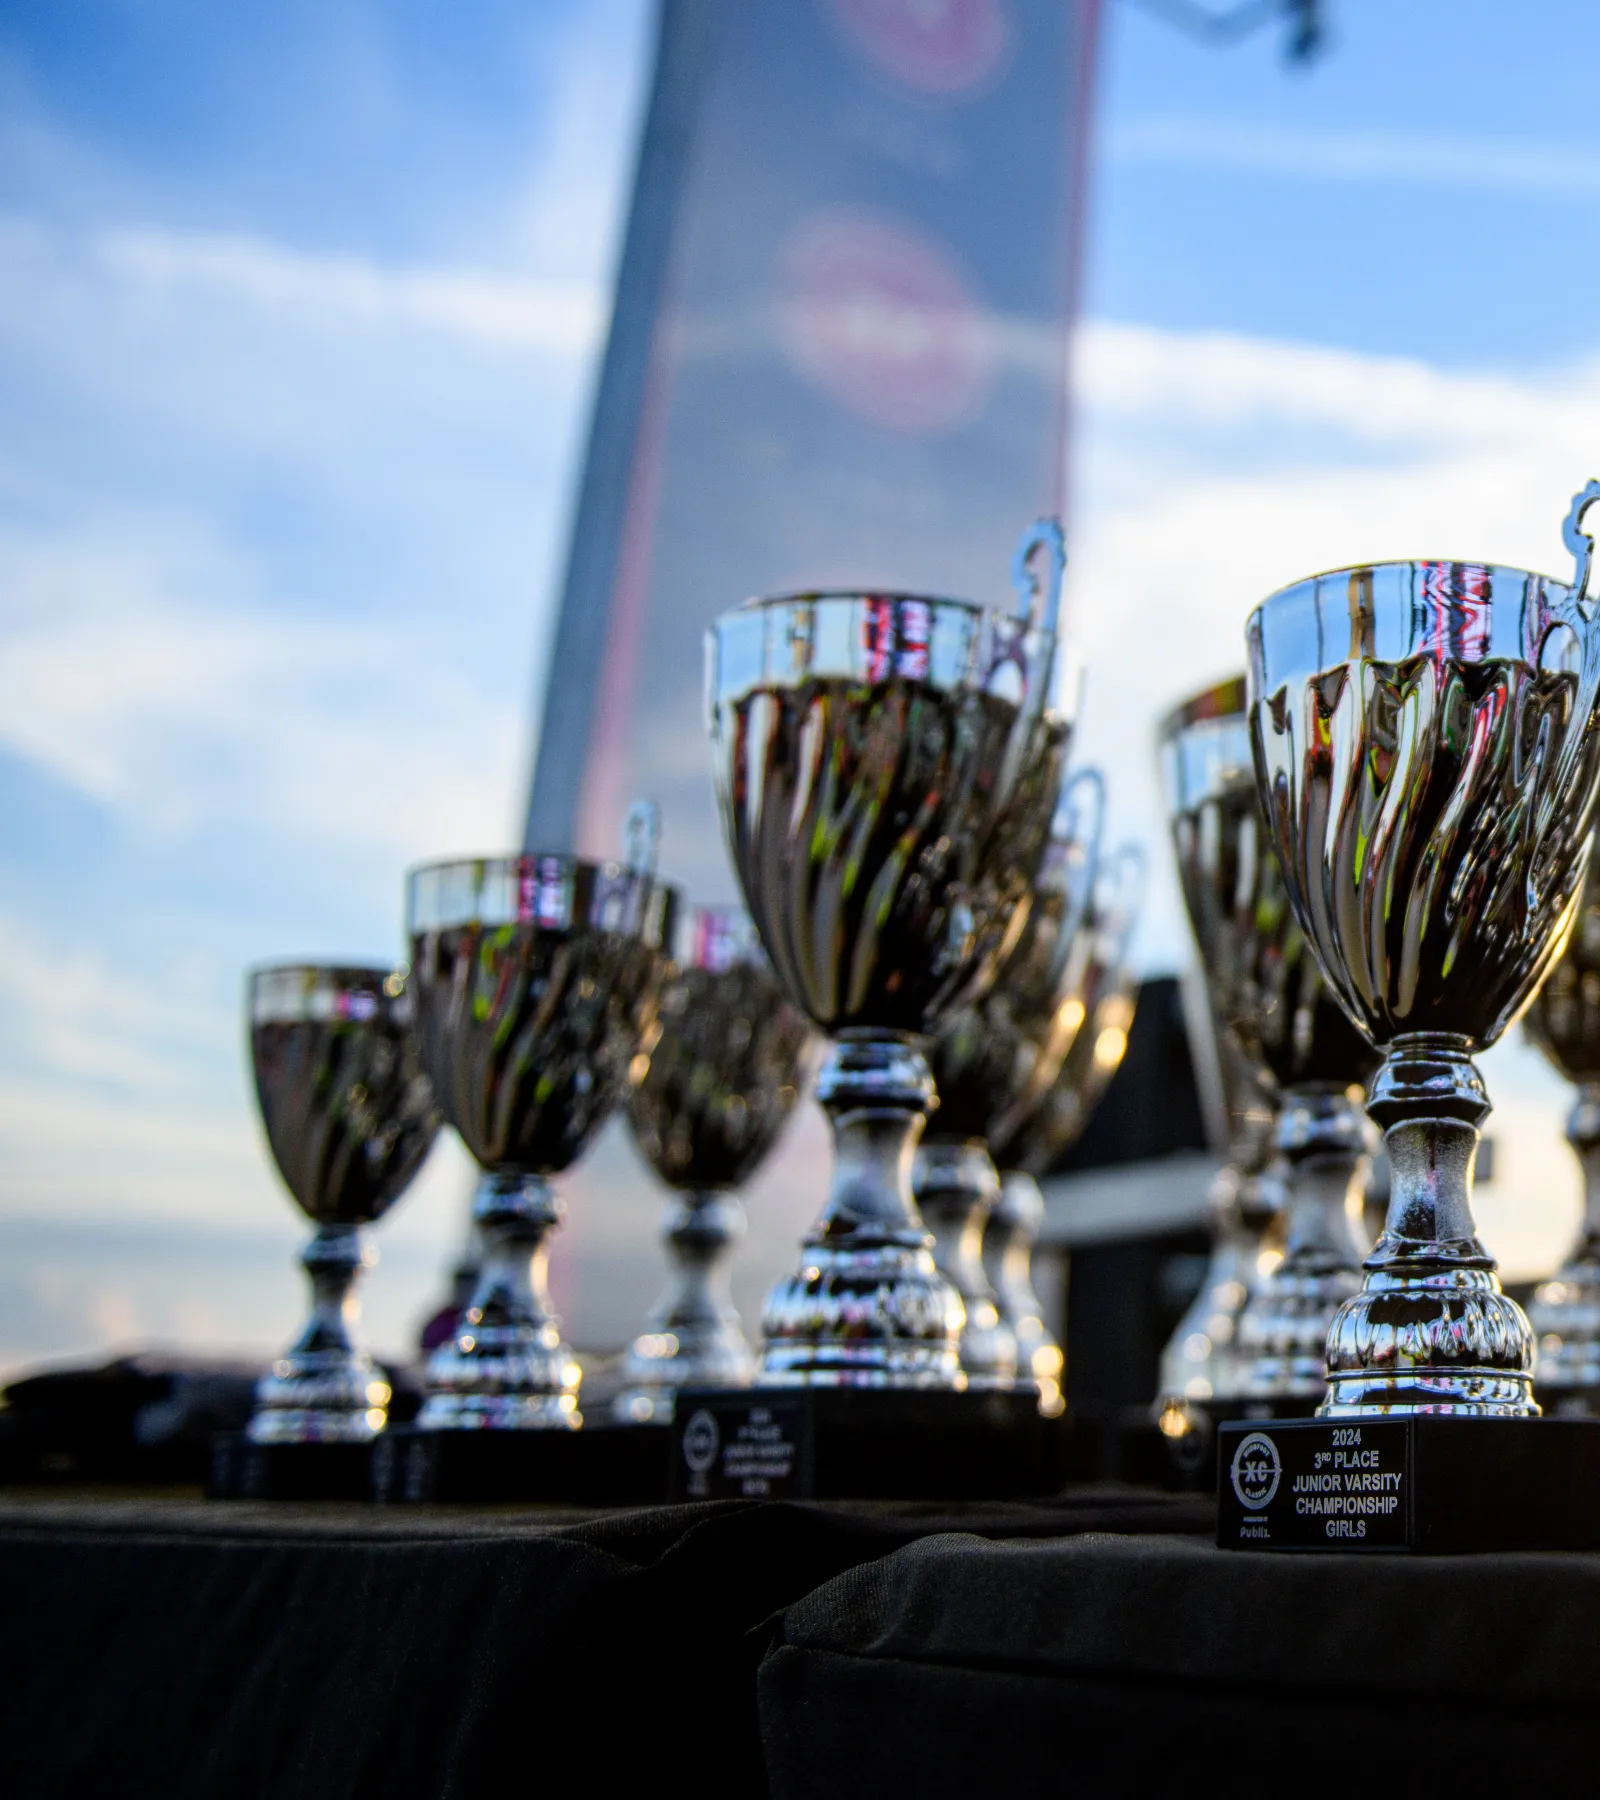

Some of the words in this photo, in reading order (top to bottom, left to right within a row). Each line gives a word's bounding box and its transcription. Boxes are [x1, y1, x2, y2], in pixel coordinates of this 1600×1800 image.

[1332, 1428, 1362, 1446] 2024
[1314, 1452, 1332, 1470] 3RD
[1334, 1450, 1380, 1469] PLACE
[1244, 1460, 1269, 1483] XC
[1292, 1474, 1341, 1493] JUNIOR
[1344, 1473, 1402, 1491] VARSITY
[1296, 1496, 1398, 1514] CHAMPIONSHIP
[1326, 1520, 1367, 1537] GIRLS
